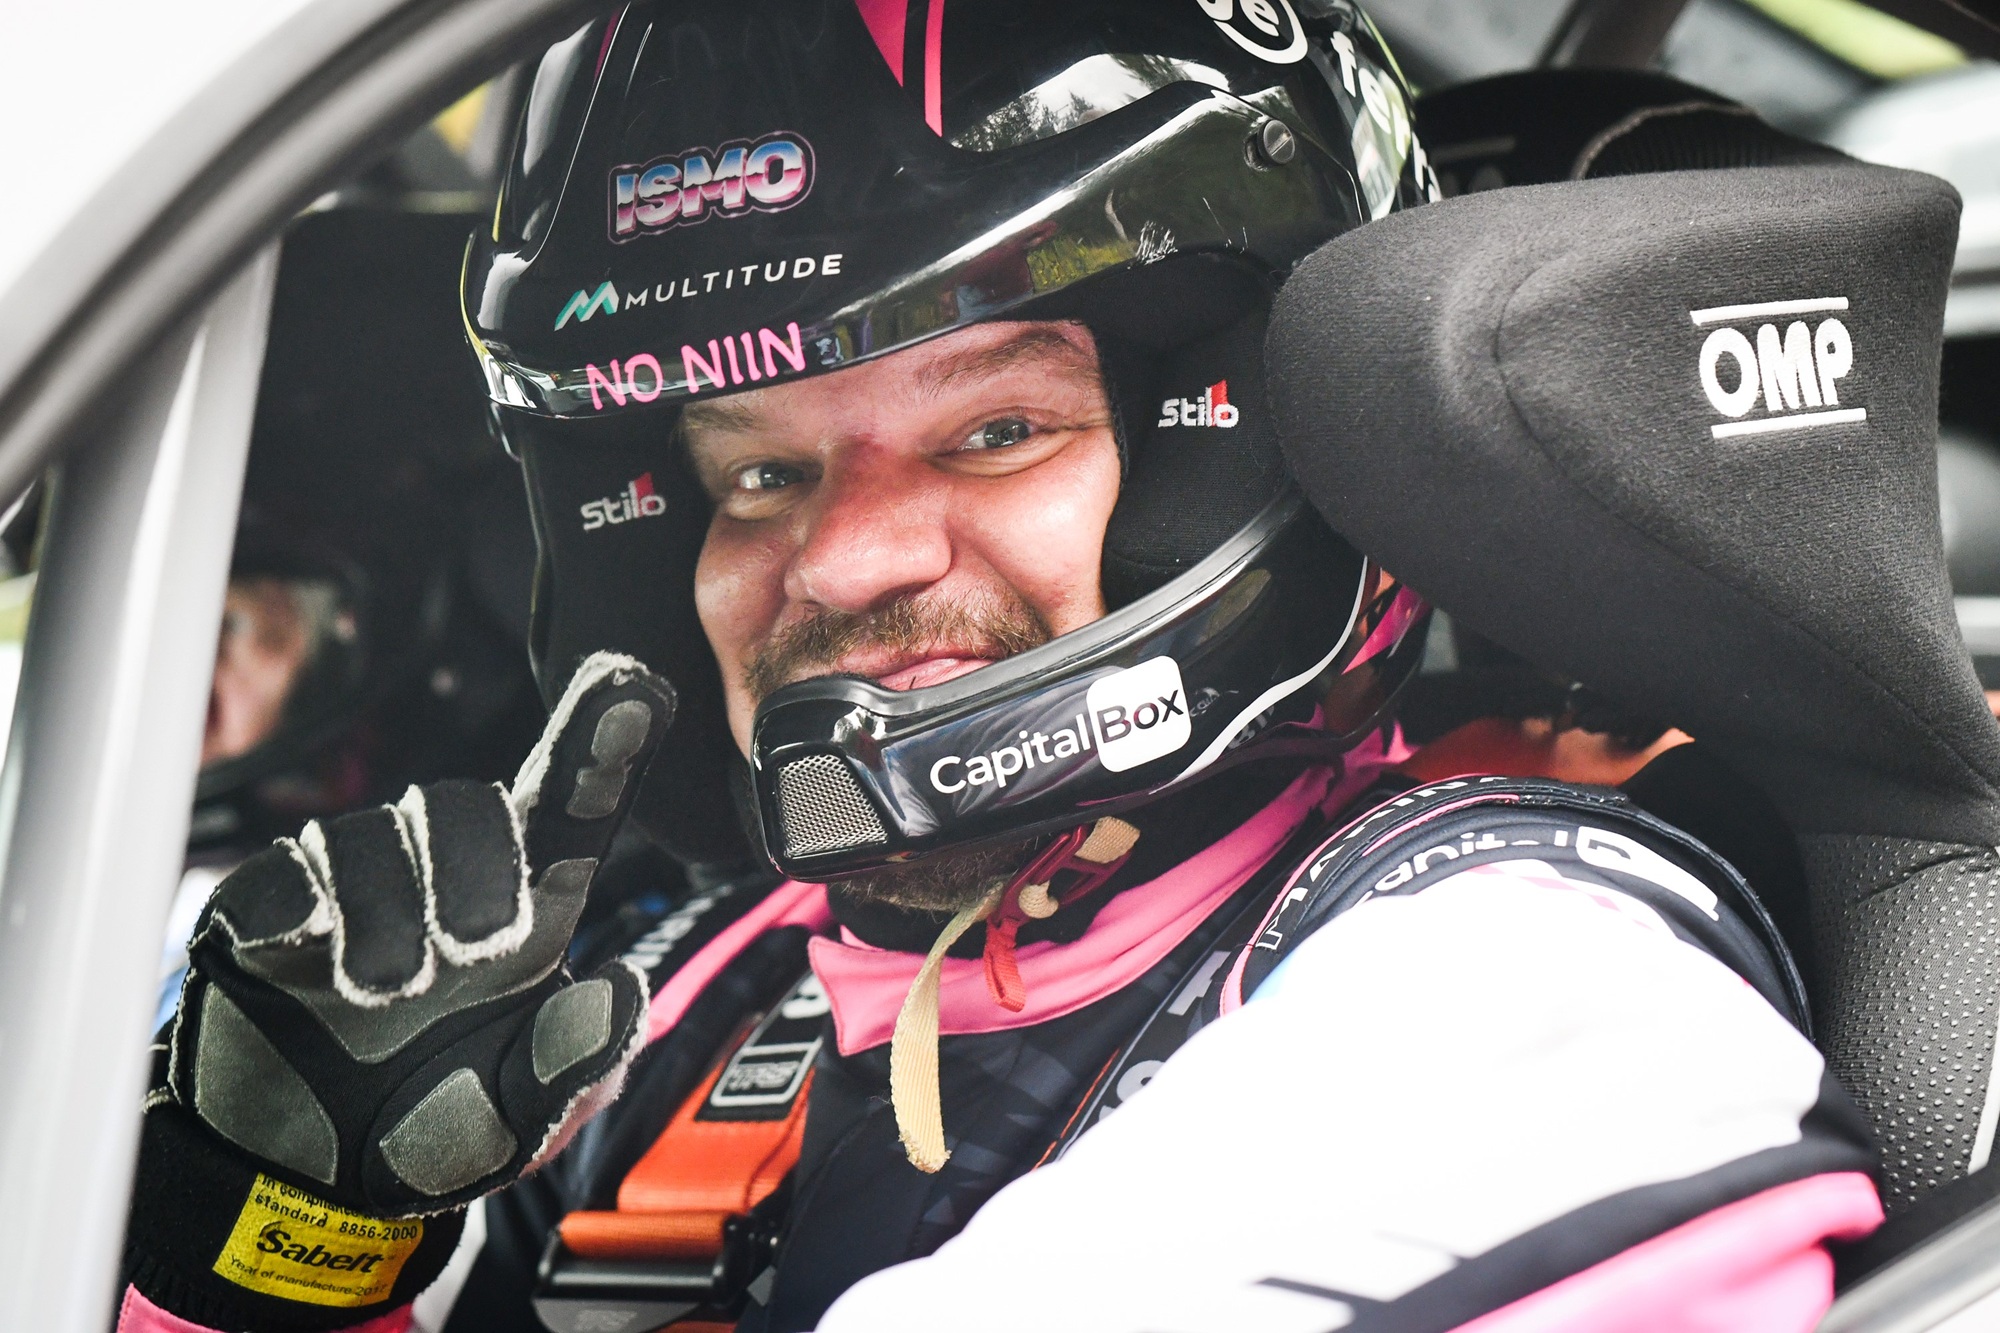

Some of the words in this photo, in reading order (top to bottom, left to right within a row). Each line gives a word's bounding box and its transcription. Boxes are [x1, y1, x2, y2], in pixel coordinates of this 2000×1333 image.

[615, 140, 807, 235] ISMO
[624, 253, 844, 310] MULTITUDE
[586, 352, 664, 410] NO
[681, 321, 806, 394] NIIN
[1699, 317, 1853, 418] OMP
[255, 1193, 329, 1228] standard
[338, 1220, 418, 1242] 8856-2000
[230, 1254, 258, 1276] Year
[260, 1270, 275, 1279] of
[275, 1273, 352, 1294] manufacture
[255, 1225, 385, 1275] Sabelt
